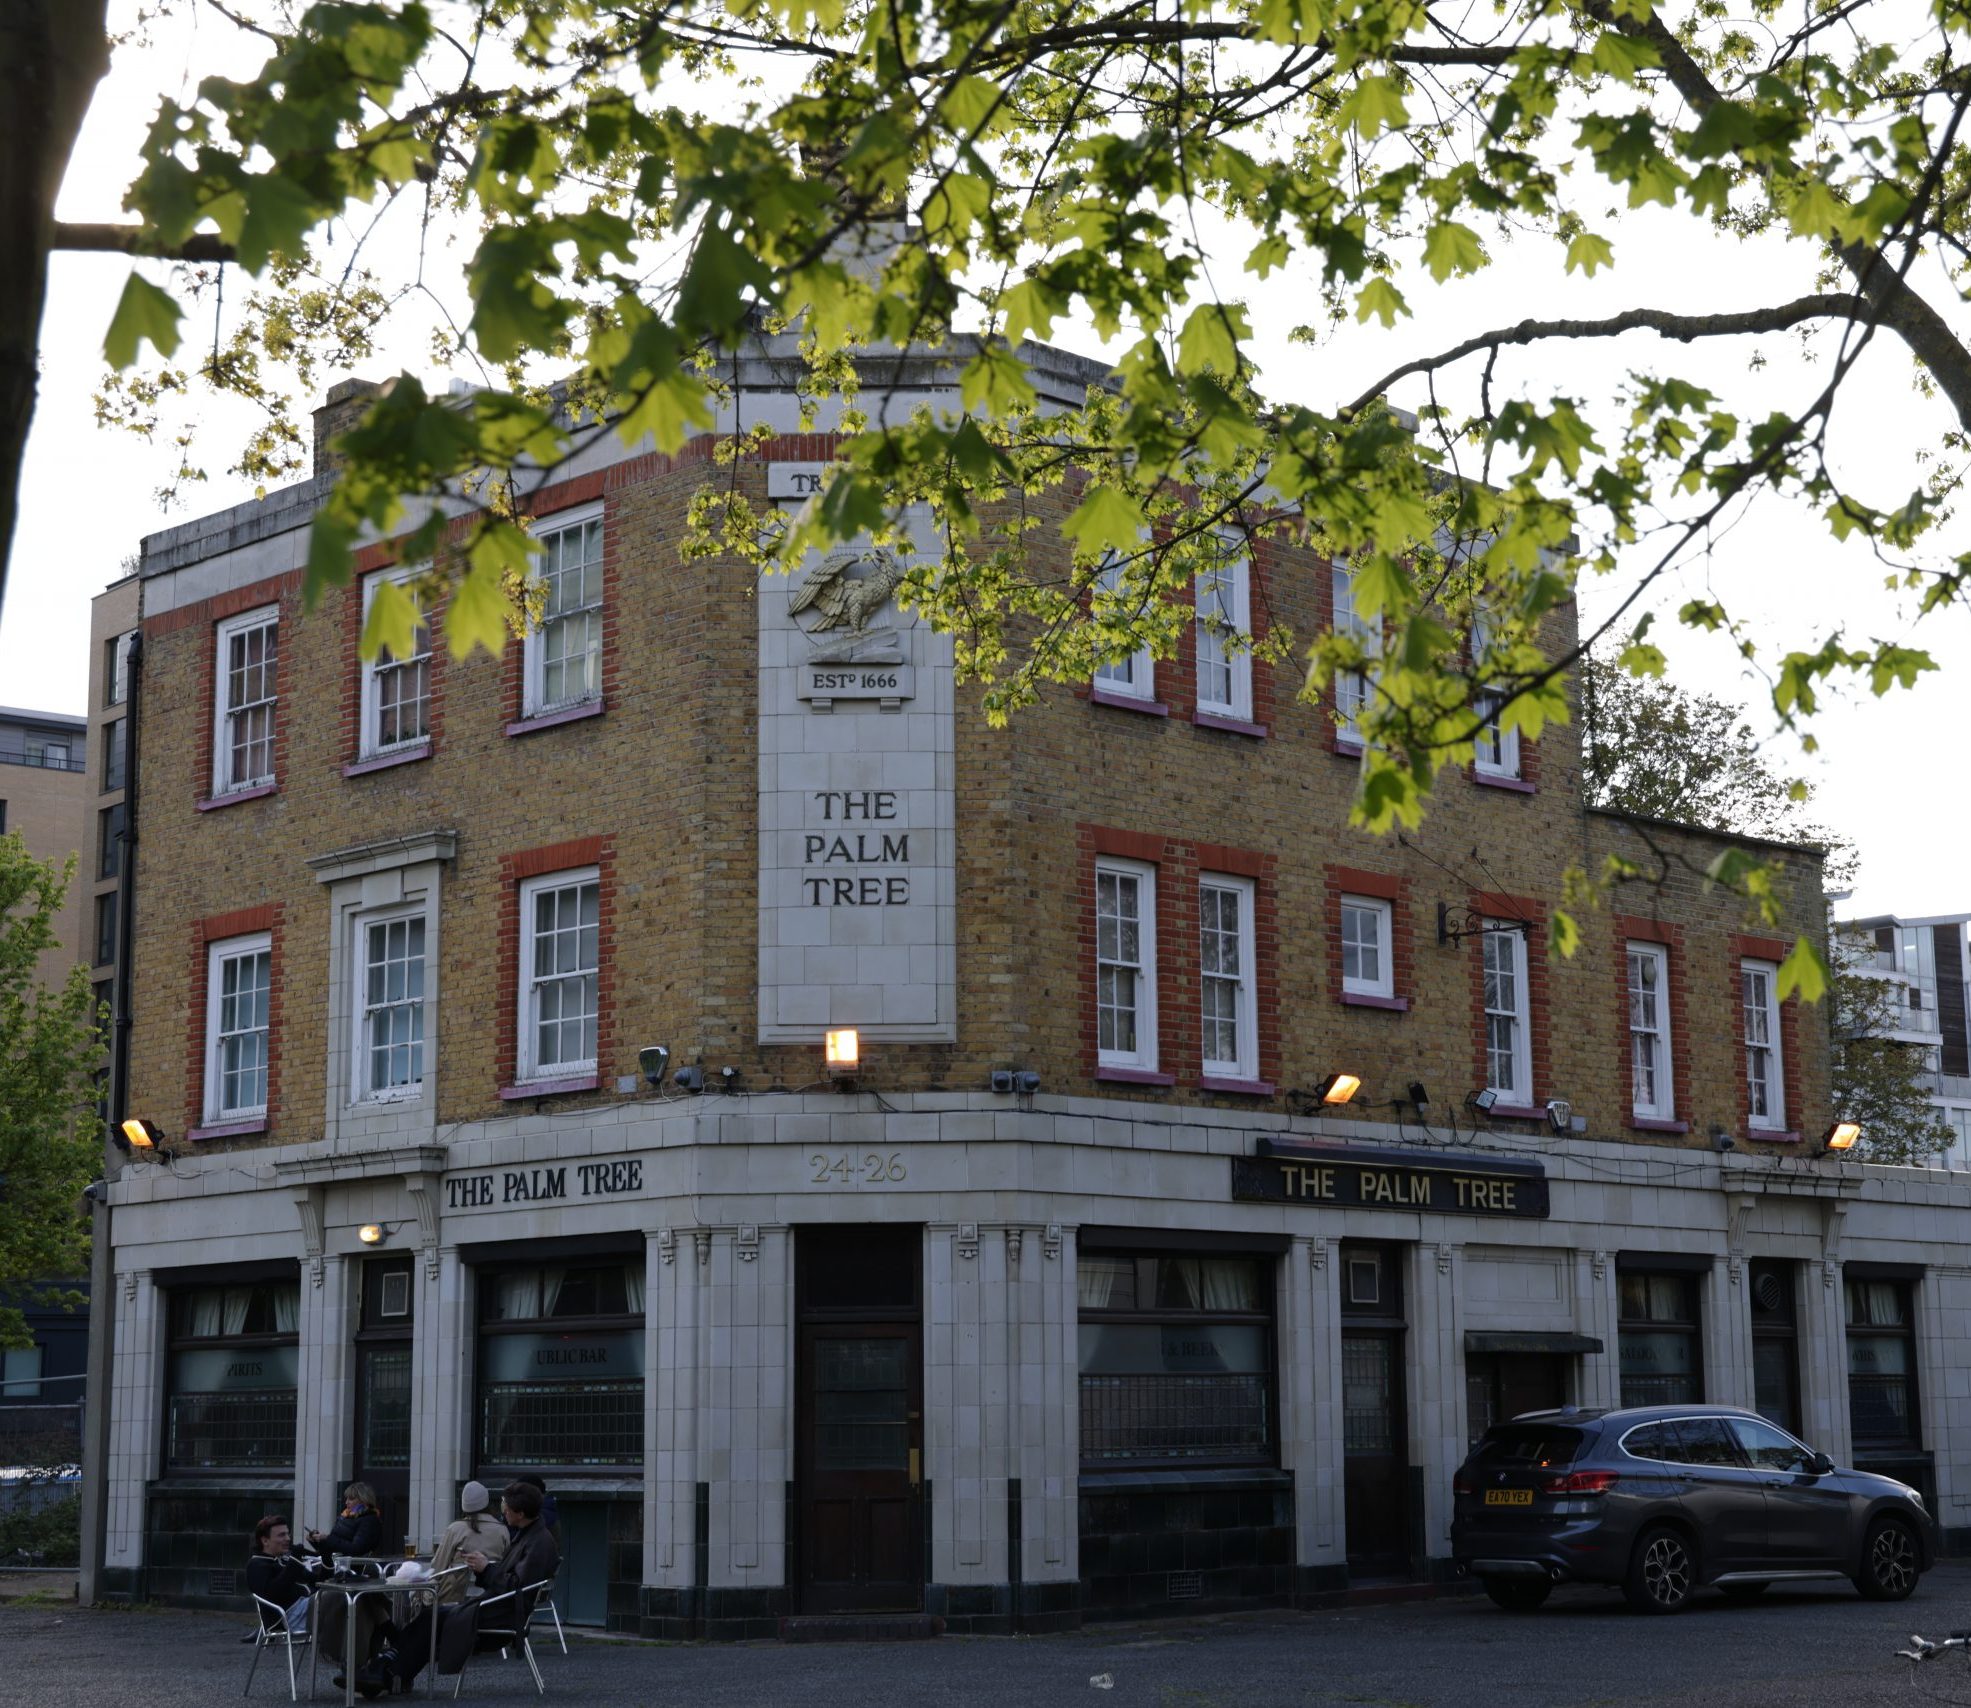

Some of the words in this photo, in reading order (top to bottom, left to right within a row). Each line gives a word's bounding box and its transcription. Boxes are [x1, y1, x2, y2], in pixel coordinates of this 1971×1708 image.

[861, 673, 897, 688] 1666
[815, 792, 897, 819] THE
[804, 834, 909, 863] PALM
[803, 877, 910, 905] TREE
[809, 1152, 906, 1182] 24-26
[445, 1175, 493, 1207] THE
[502, 1167, 566, 1202] PALM
[577, 1159, 643, 1195] TREE
[1280, 1166, 1335, 1198] THE
[1359, 1171, 1431, 1205] PALM
[1453, 1178, 1516, 1209] TREE
[226, 1362, 263, 1377] PIRITS
[536, 1349, 576, 1365] UBLIC
[578, 1347, 607, 1363] BAR
